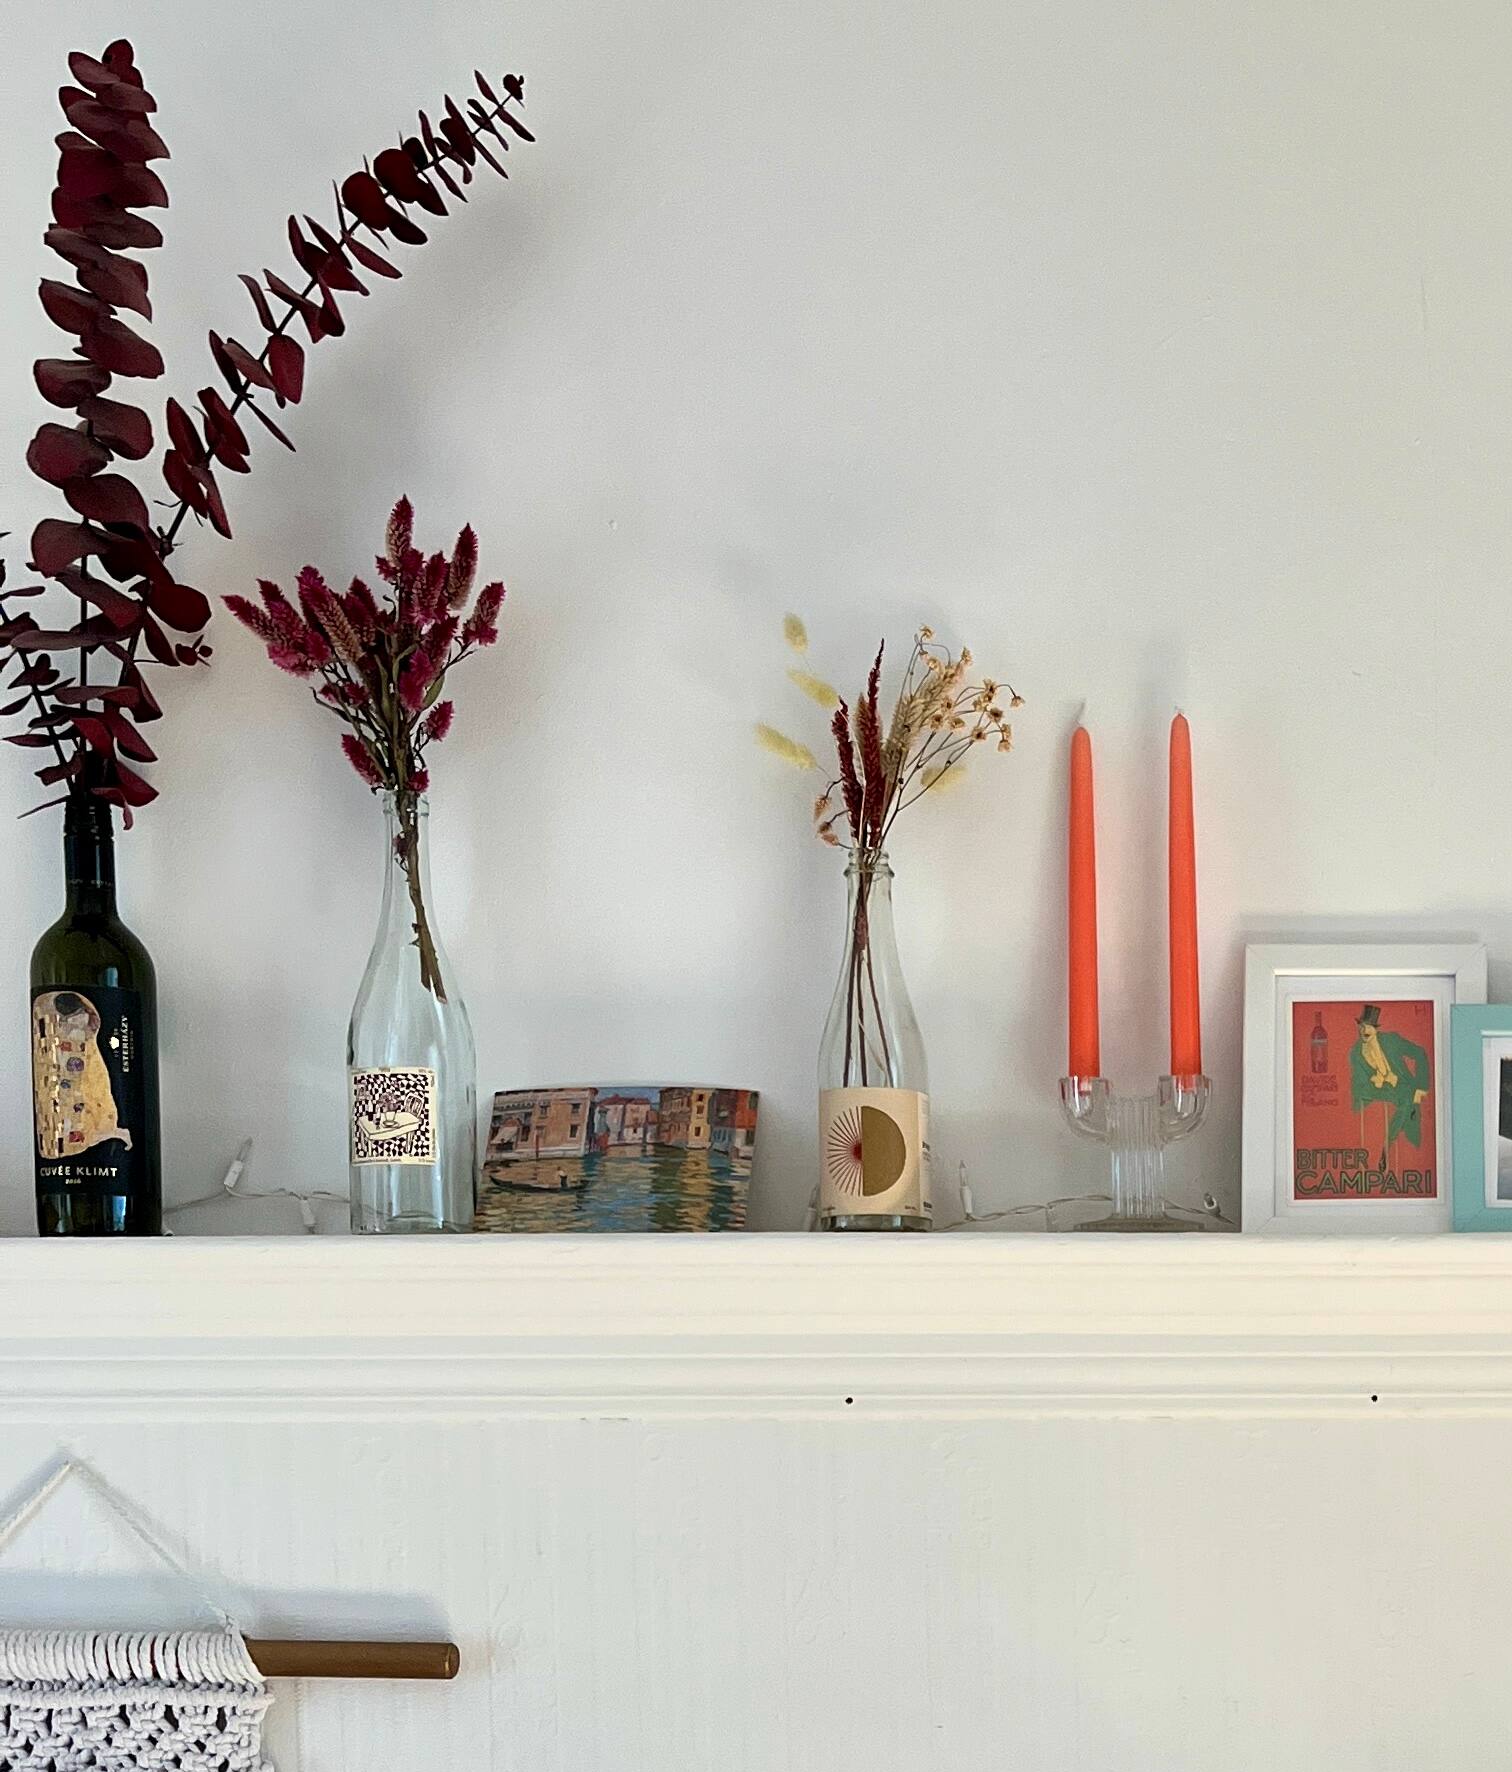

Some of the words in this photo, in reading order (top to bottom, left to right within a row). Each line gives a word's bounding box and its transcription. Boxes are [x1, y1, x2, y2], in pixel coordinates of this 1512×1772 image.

[1297, 1149, 1369, 1169] BITTER
[40, 1166, 71, 1176] CUVÉE
[77, 1167, 118, 1177] KLIMT
[1296, 1170, 1432, 1195] CAMPARI
